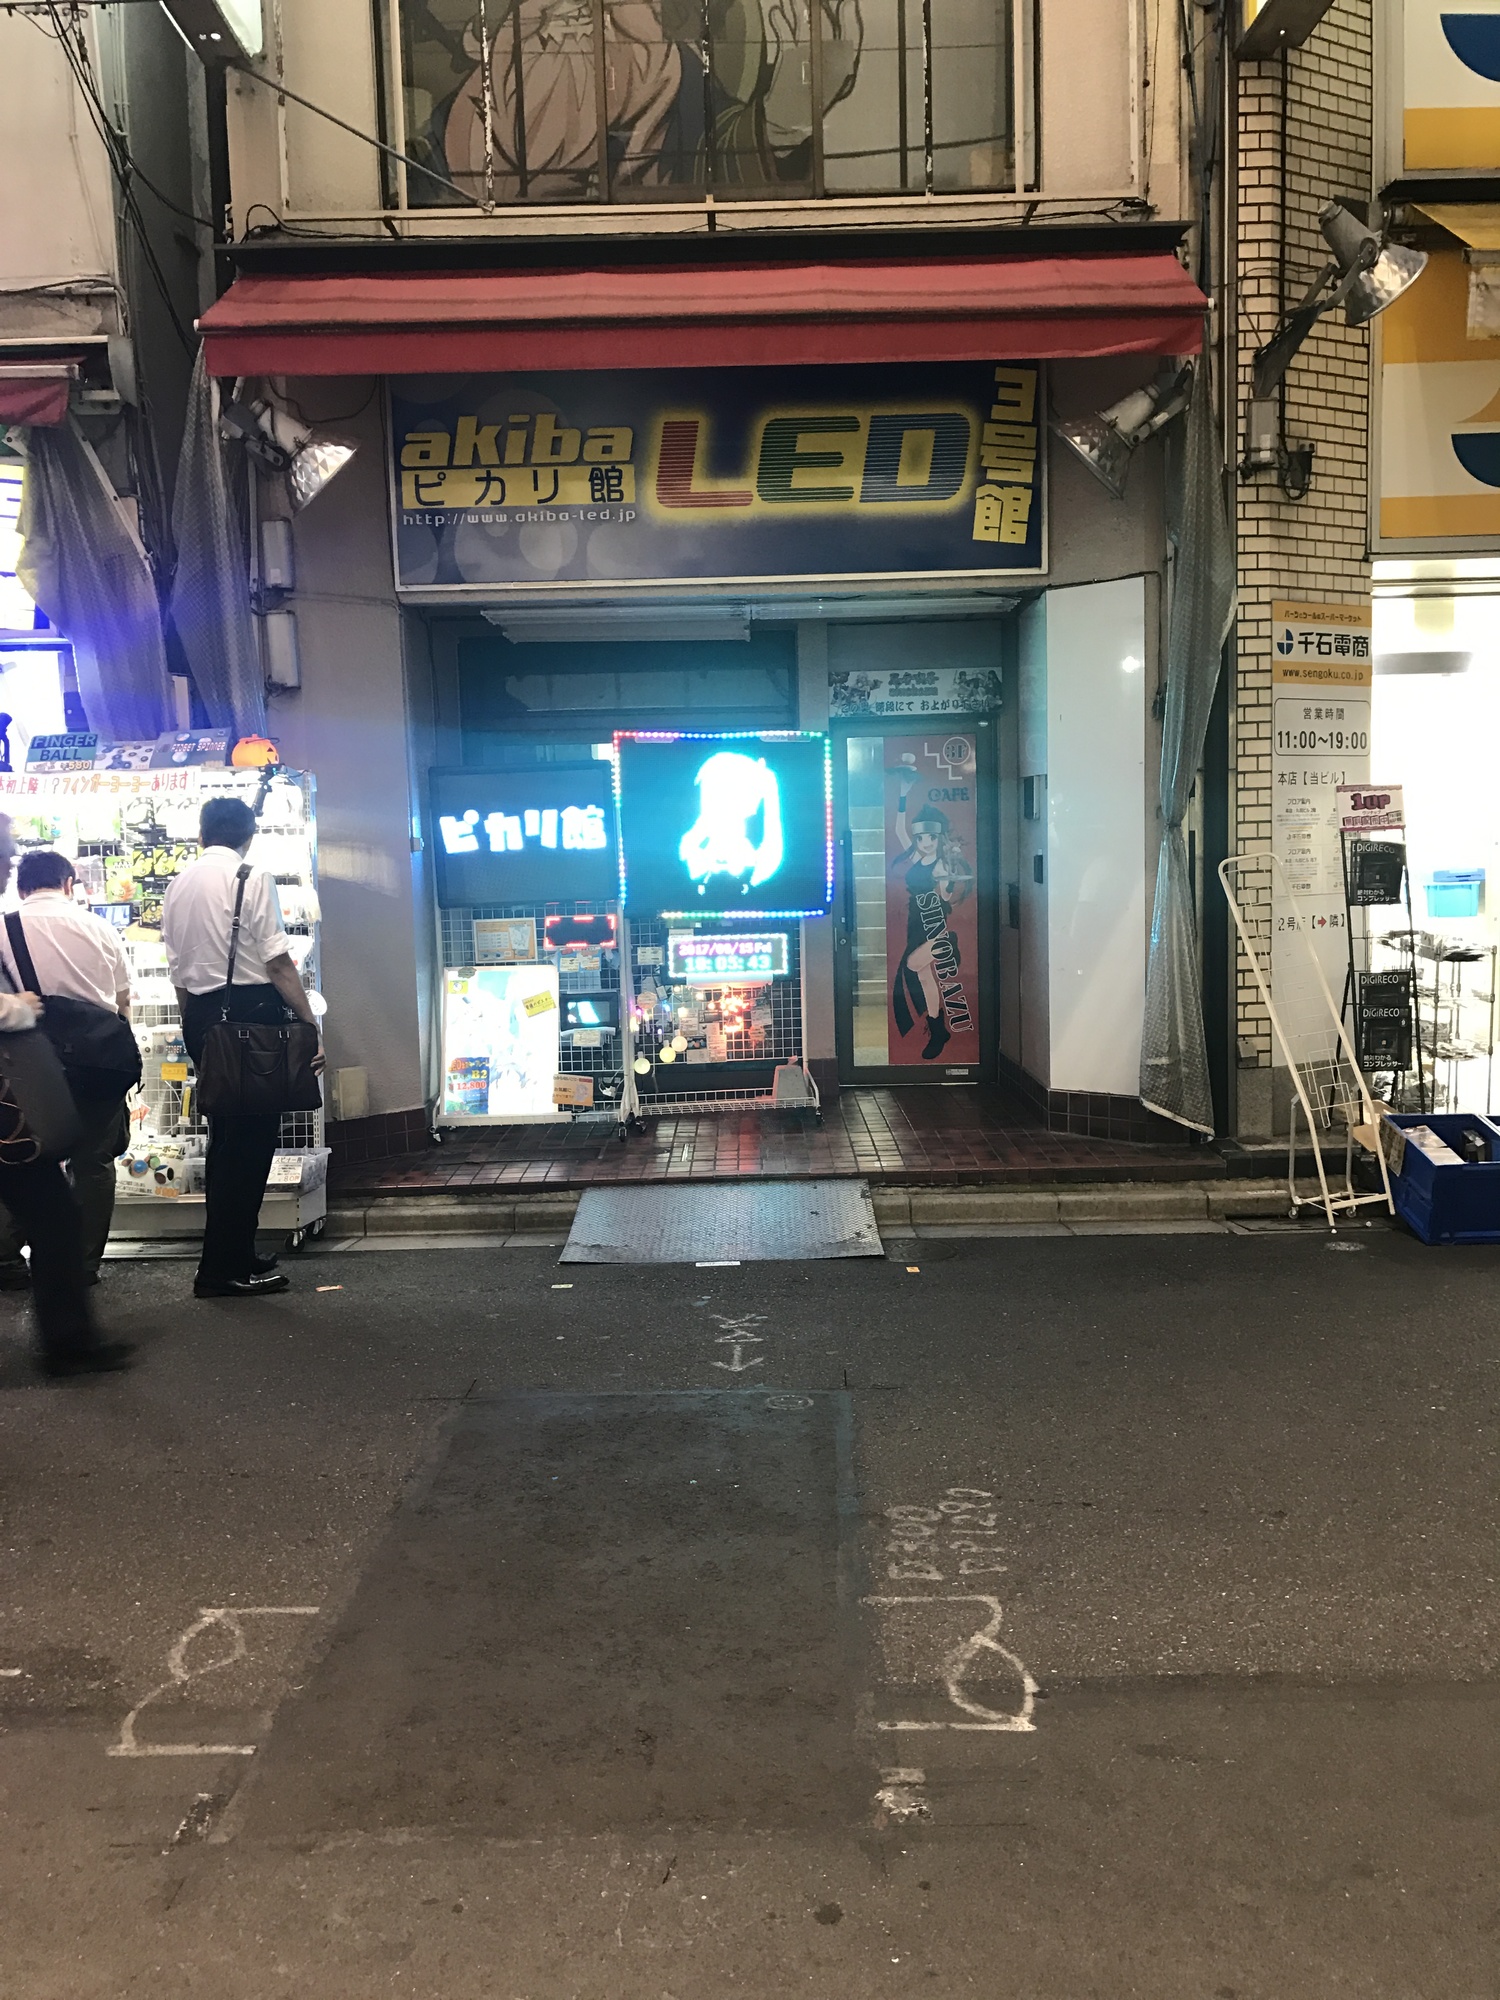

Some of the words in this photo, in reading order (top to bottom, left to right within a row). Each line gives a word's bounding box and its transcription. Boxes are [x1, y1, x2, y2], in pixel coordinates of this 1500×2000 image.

[400, 413, 634, 467] akiba
[656, 411, 972, 510] LED
[412, 465, 626, 507] ピカリ館
[403, 508, 637, 527] http://www.akiba-led.jp
[1297, 631, 1369, 658] 千石電商
[1282, 667, 1364, 681] www.sengoku.co.jp
[1303, 707, 1345, 721] 営業時間
[33, 734, 97, 748] FINGER
[40, 749, 82, 761] BALL
[1277, 771, 1347, 786] 本店【当ビル】
[928, 787, 970, 802] CAFE
[439, 804, 607, 854] ピカリ館
[915, 891, 974, 1033] SINOBAZU
